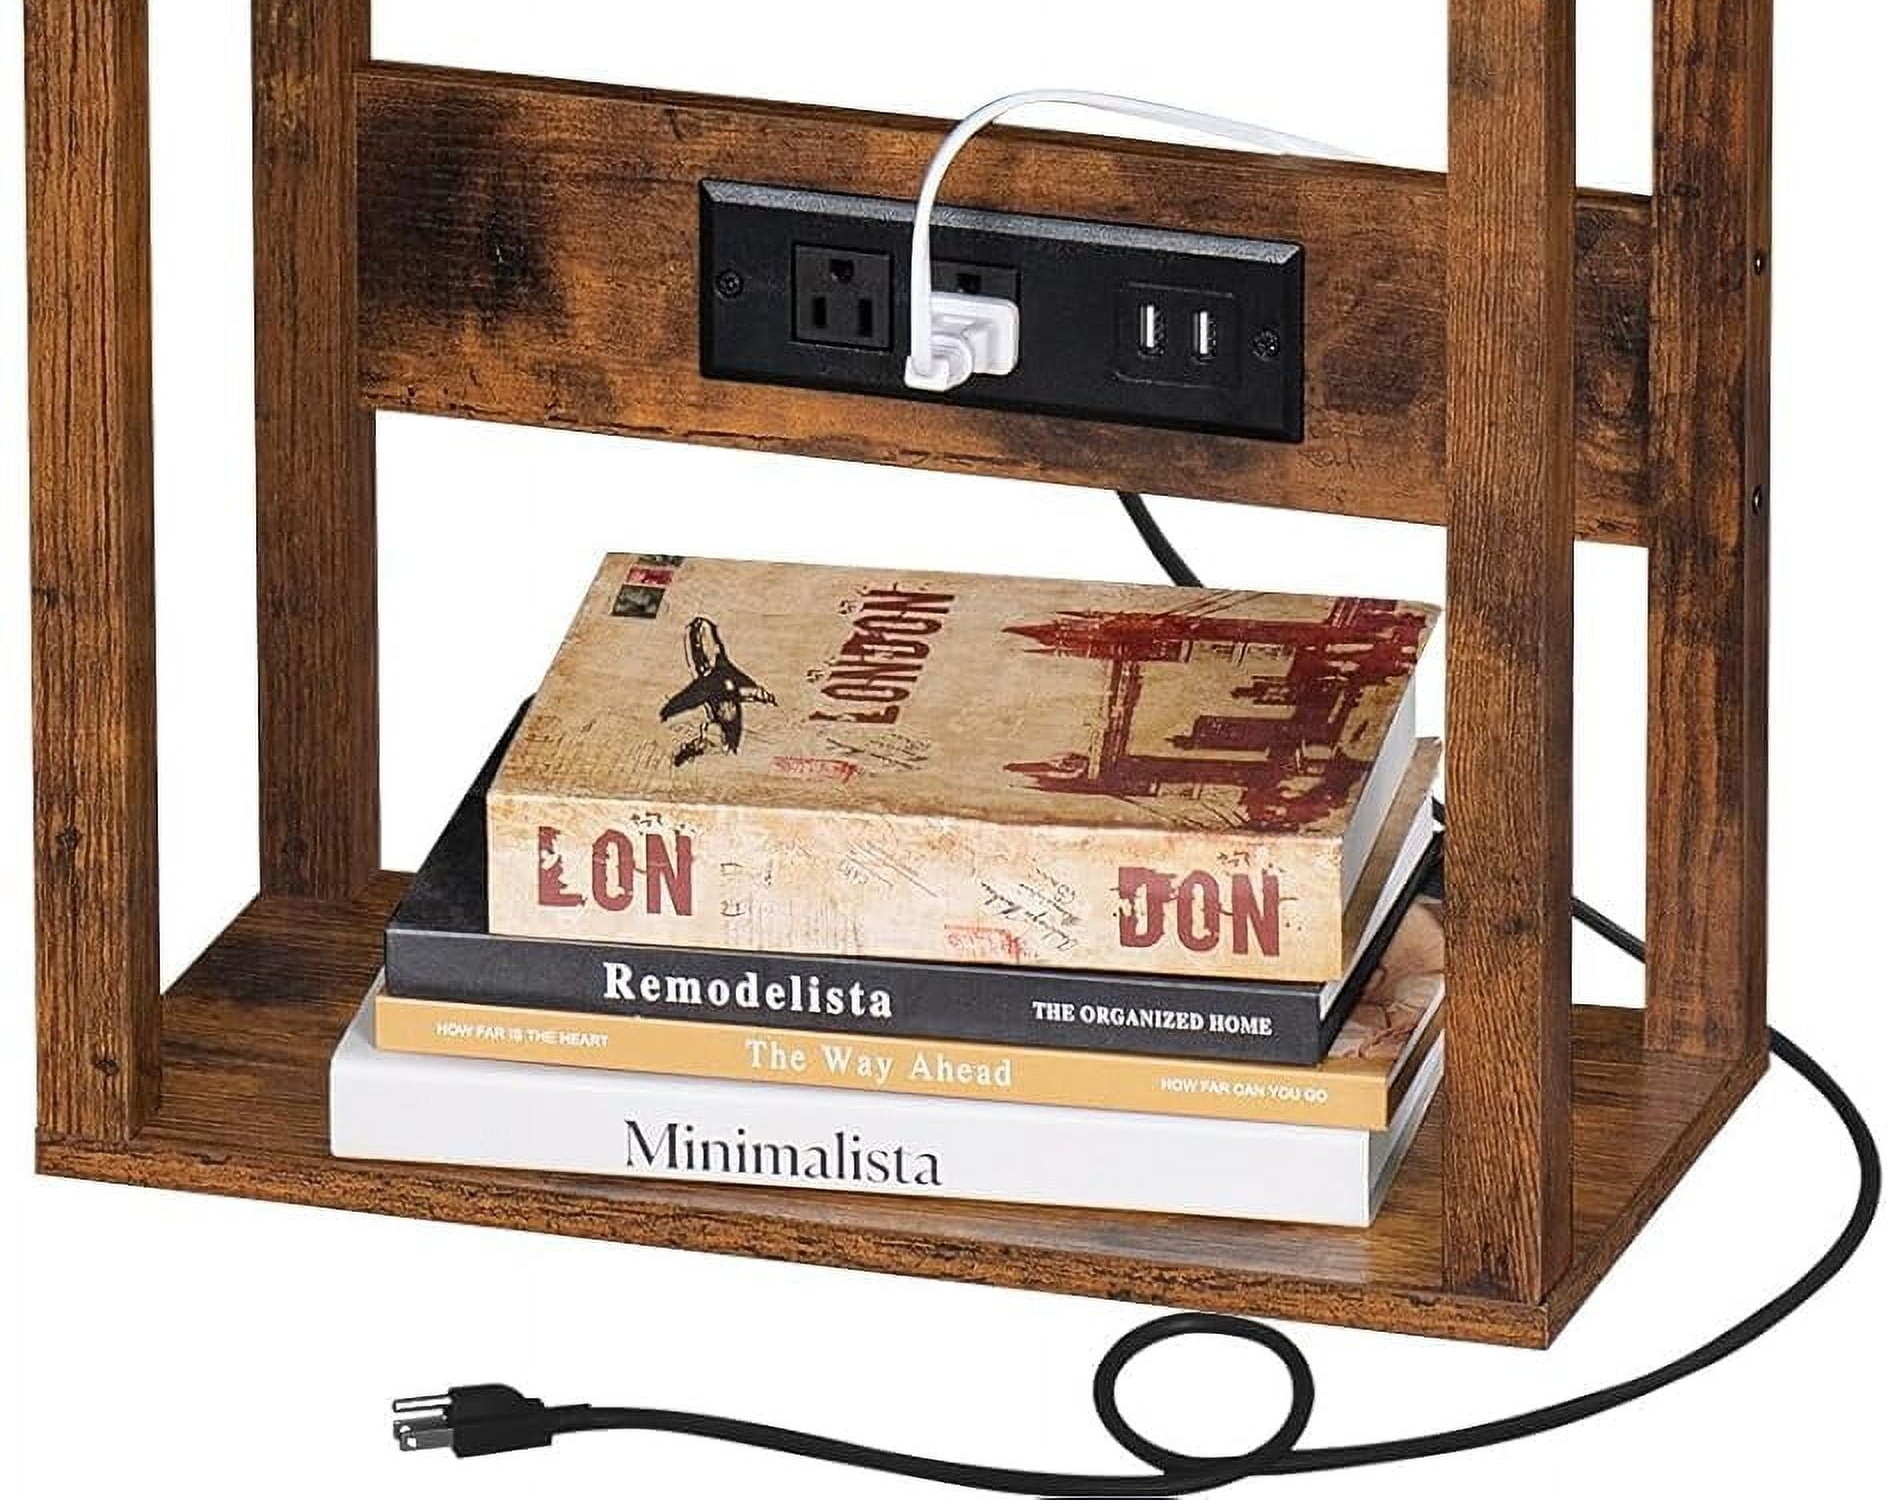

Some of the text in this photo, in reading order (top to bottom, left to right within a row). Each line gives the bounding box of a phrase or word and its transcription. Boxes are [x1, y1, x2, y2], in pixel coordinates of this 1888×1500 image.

[808, 589, 955, 725] LONDON
[537, 825, 694, 917] LON
[1117, 865, 1281, 958] DON
[602, 961, 893, 1019] Remodelista
[436, 1021, 608, 1048] HOW FAR IS THE HEART
[1032, 1001, 1273, 1036] THE ORGANIZED HOME
[745, 1039, 1012, 1087] The Way Ahead
[1160, 1077, 1329, 1104] HOW FAR CAN YOU GO
[623, 1118, 943, 1186] Minimalista
